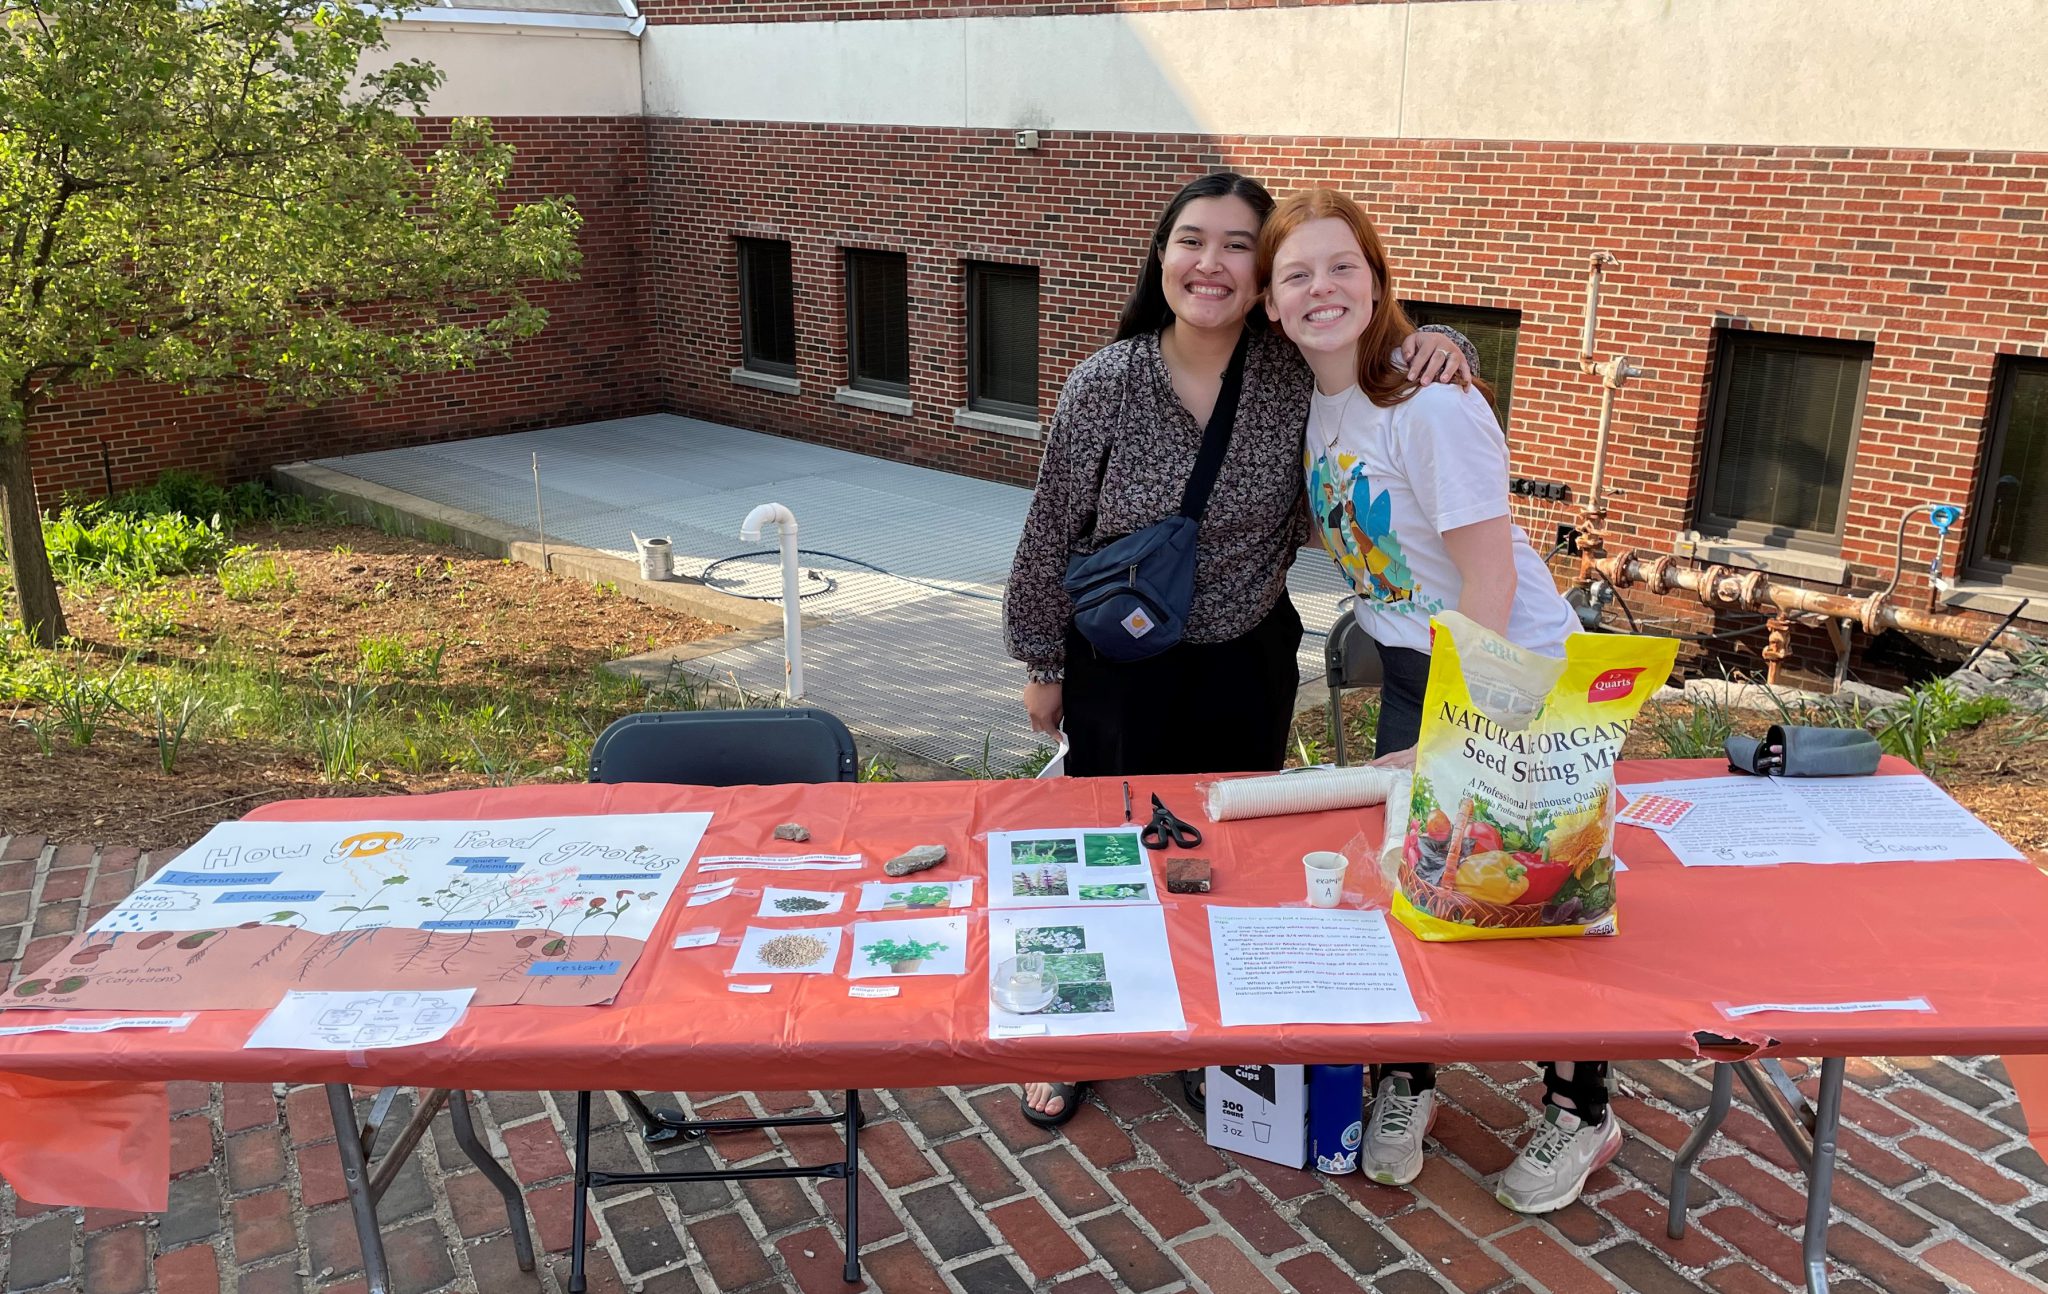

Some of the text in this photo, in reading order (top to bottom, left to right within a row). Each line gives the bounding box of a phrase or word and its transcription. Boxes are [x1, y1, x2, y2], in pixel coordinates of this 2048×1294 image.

[1594, 679, 1631, 691] Quarts
[1438, 701, 1634, 755] NATURA ORGAN
[1462, 737, 1507, 776] Seed
[1581, 746, 1618, 773] Mi
[1468, 777, 1476, 788] A
[1476, 780, 1528, 810] Professional
[1529, 796, 1571, 809] eenhouse
[203, 844, 312, 870] How
[323, 836, 440, 865] your
[538, 840, 681, 872] grows
[183, 874, 269, 885] Germination
[1325, 888, 1332, 897] A
[1234, 1068, 1260, 1082] Cups
[1221, 1099, 1244, 1113] 300
[1222, 1109, 1245, 1119] count
[1222, 1124, 1229, 1133] 3
